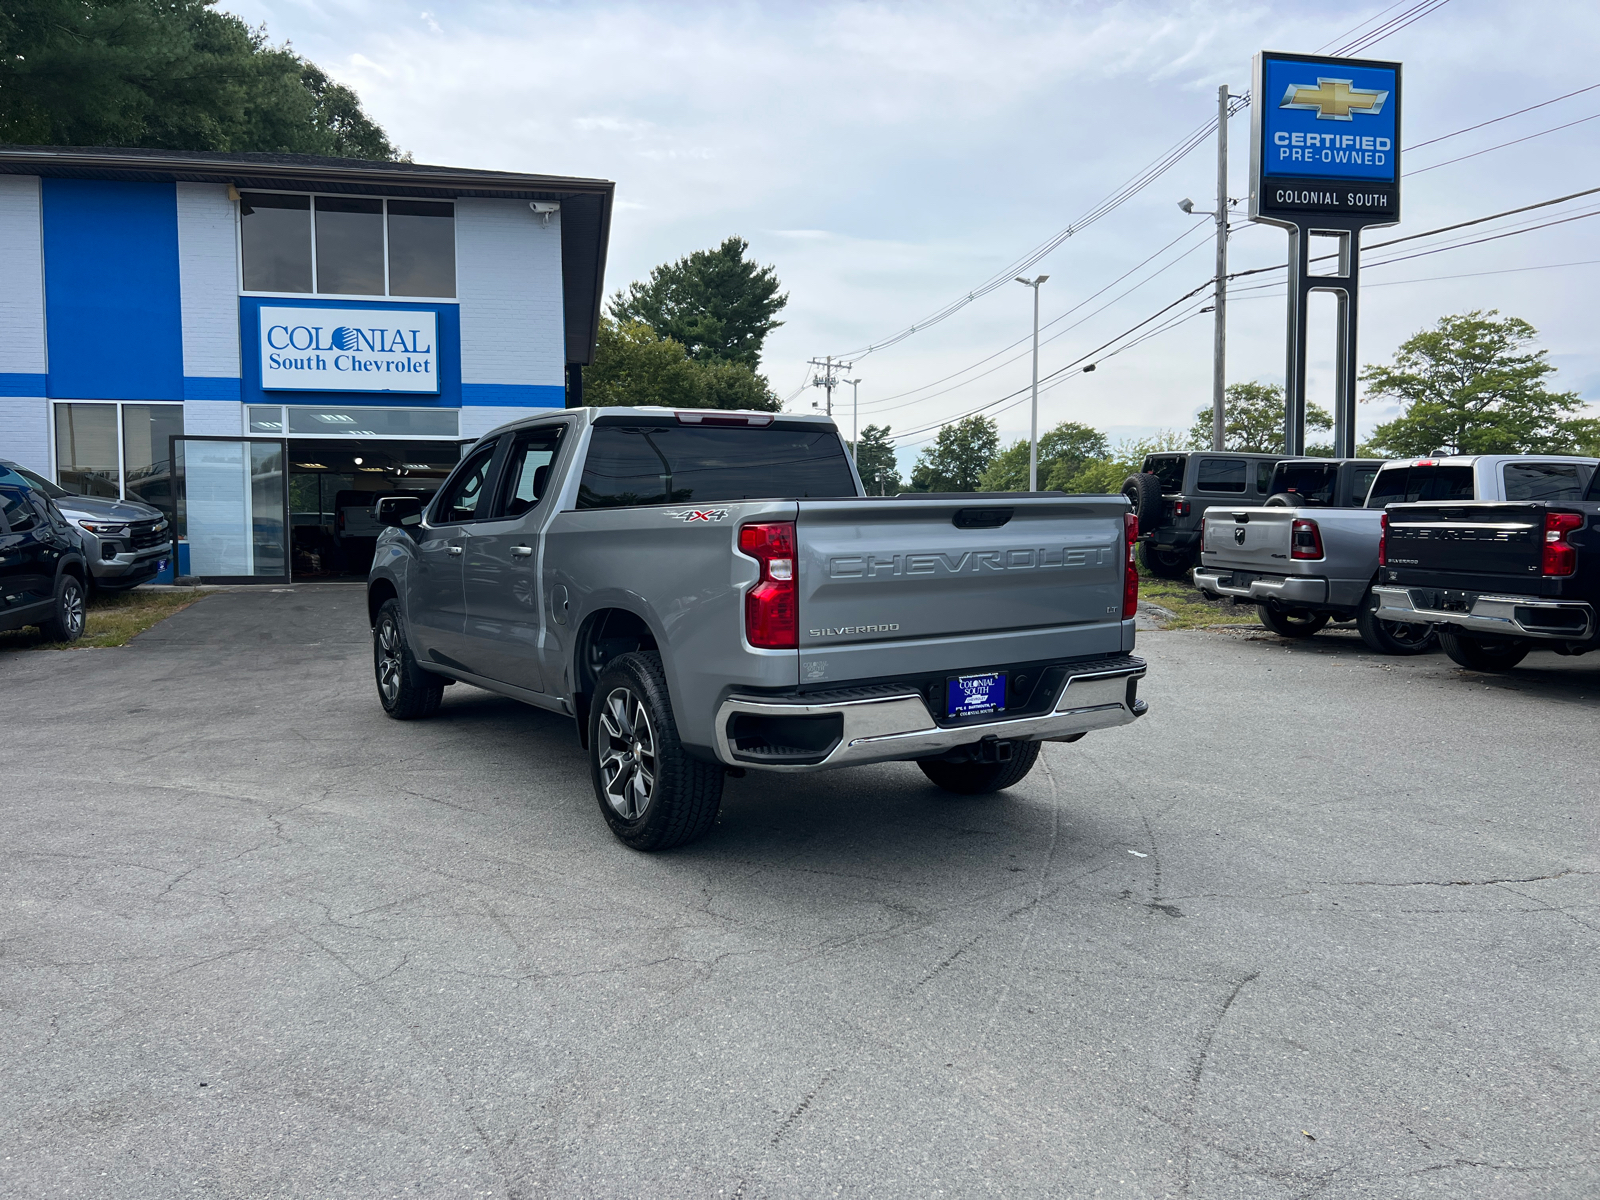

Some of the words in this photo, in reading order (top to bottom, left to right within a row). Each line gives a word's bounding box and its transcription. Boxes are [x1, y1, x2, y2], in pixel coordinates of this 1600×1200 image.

[1274, 131, 1391, 151] CERTIFIED
[1279, 148, 1385, 166] PRE-OWNED
[1276, 190, 1339, 205] COLONIAL
[1347, 193, 1387, 207] SOUTH
[267, 325, 431, 354] COLONIAL
[269, 353, 327, 370] South
[334, 355, 431, 373] Chevrolet
[829, 545, 1111, 579] CHEVROLET
[1106, 606, 1118, 614] LT
[809, 623, 900, 637] SILVERADO
[959, 678, 995, 689] COLONIAL
[964, 686, 989, 695] SOUTH
